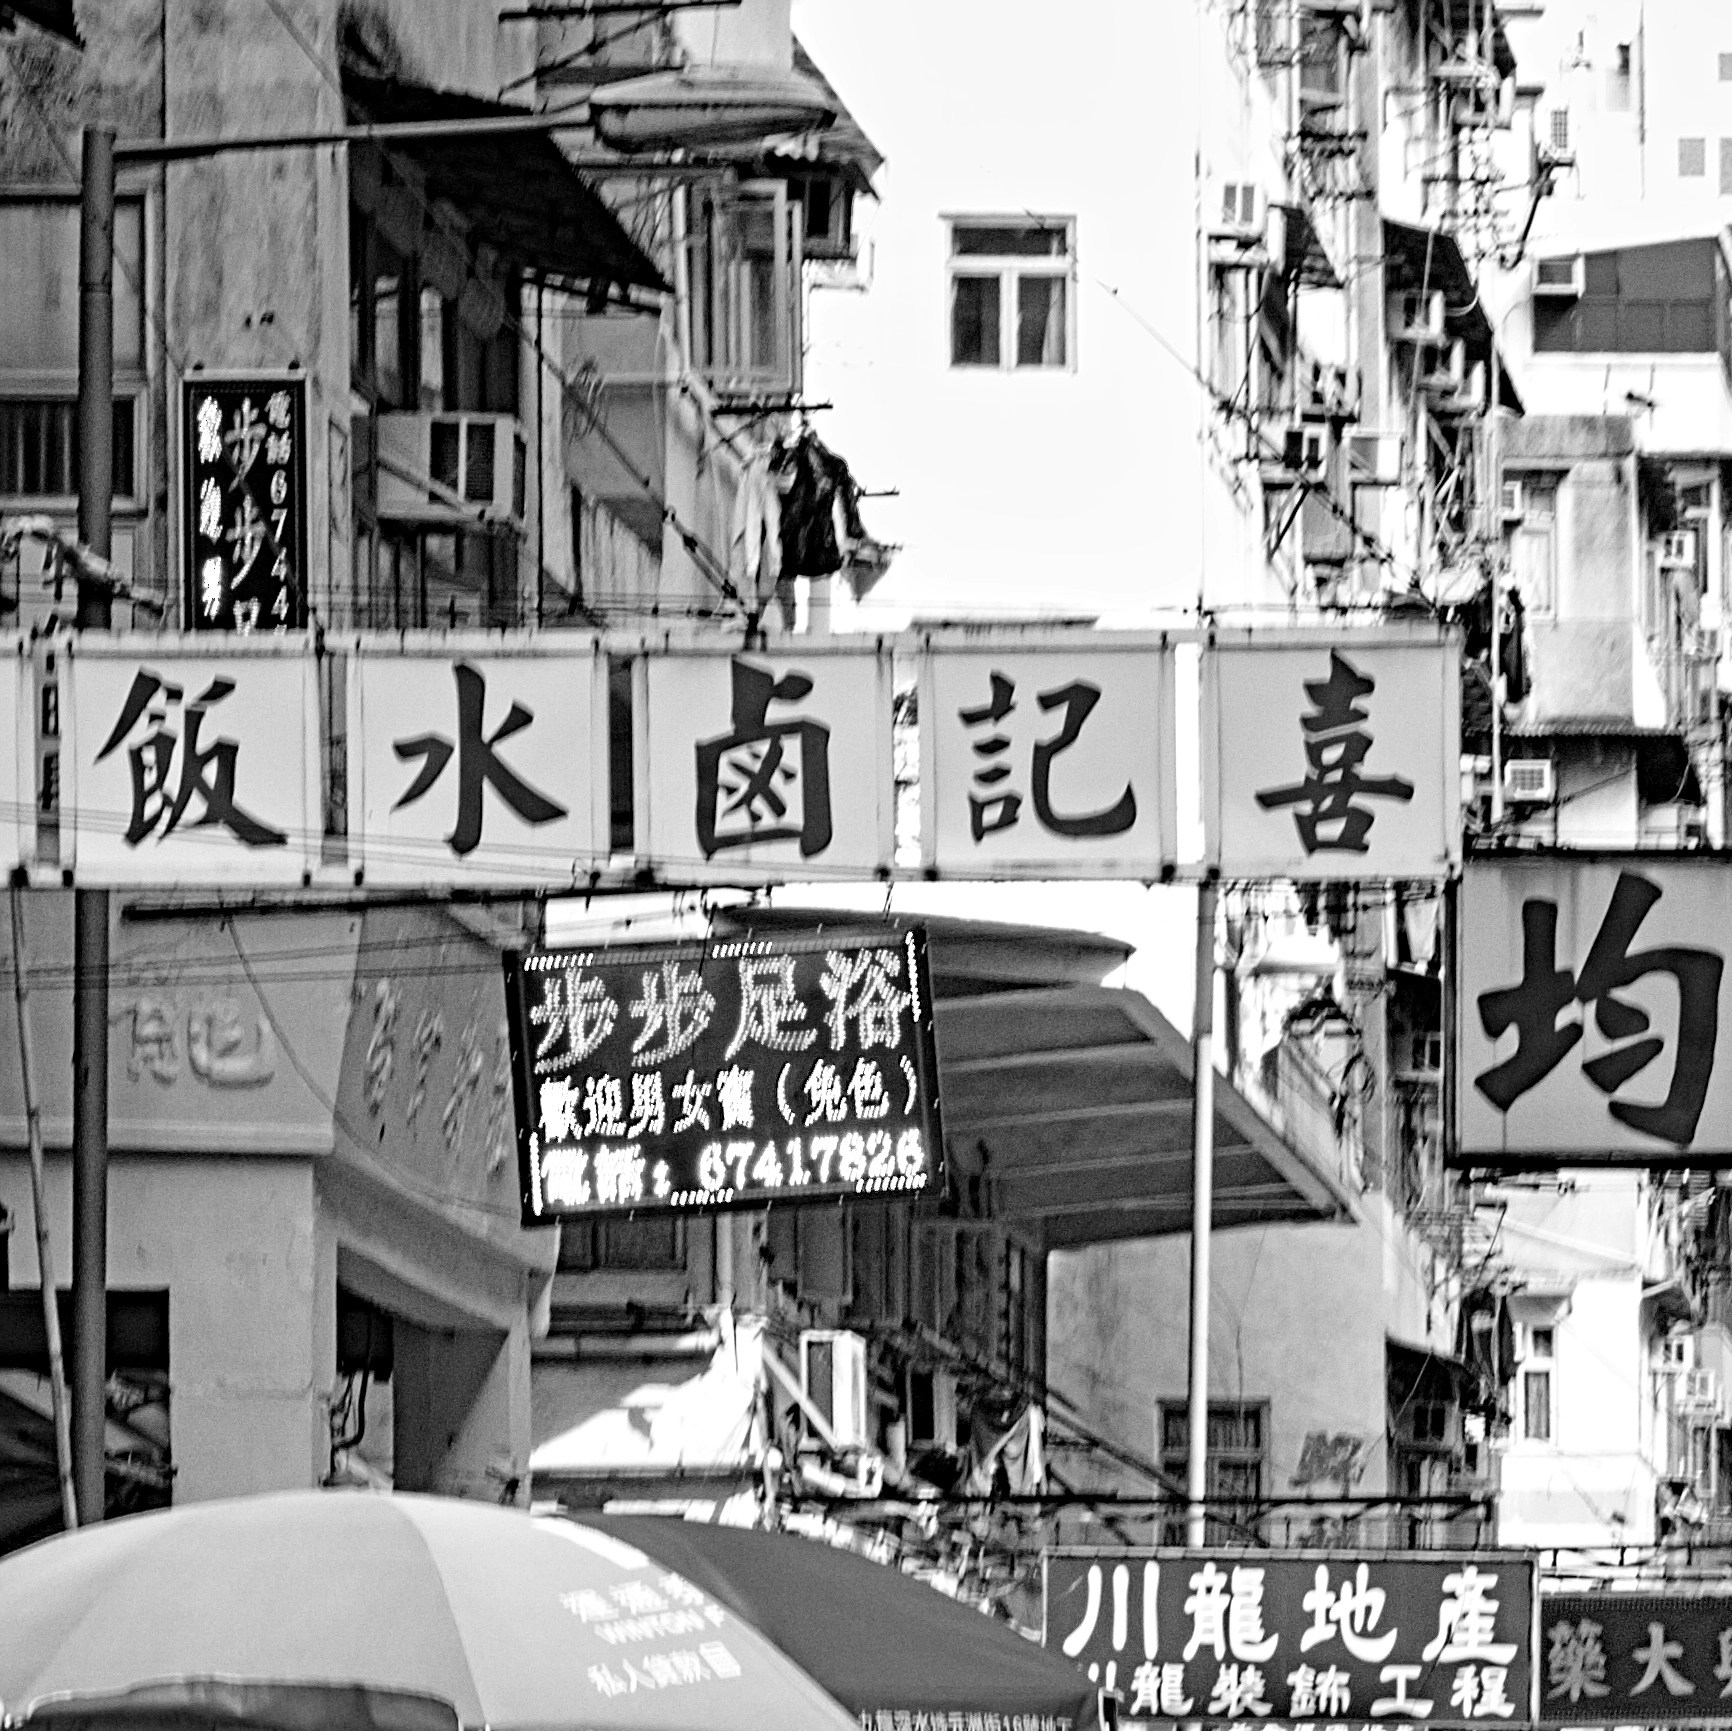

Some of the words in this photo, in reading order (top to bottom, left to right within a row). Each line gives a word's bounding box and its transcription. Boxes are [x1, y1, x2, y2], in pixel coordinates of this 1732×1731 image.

[530, 948, 911, 1074] 步步足浴
[1064, 1562, 1518, 1661] 川龍地產
